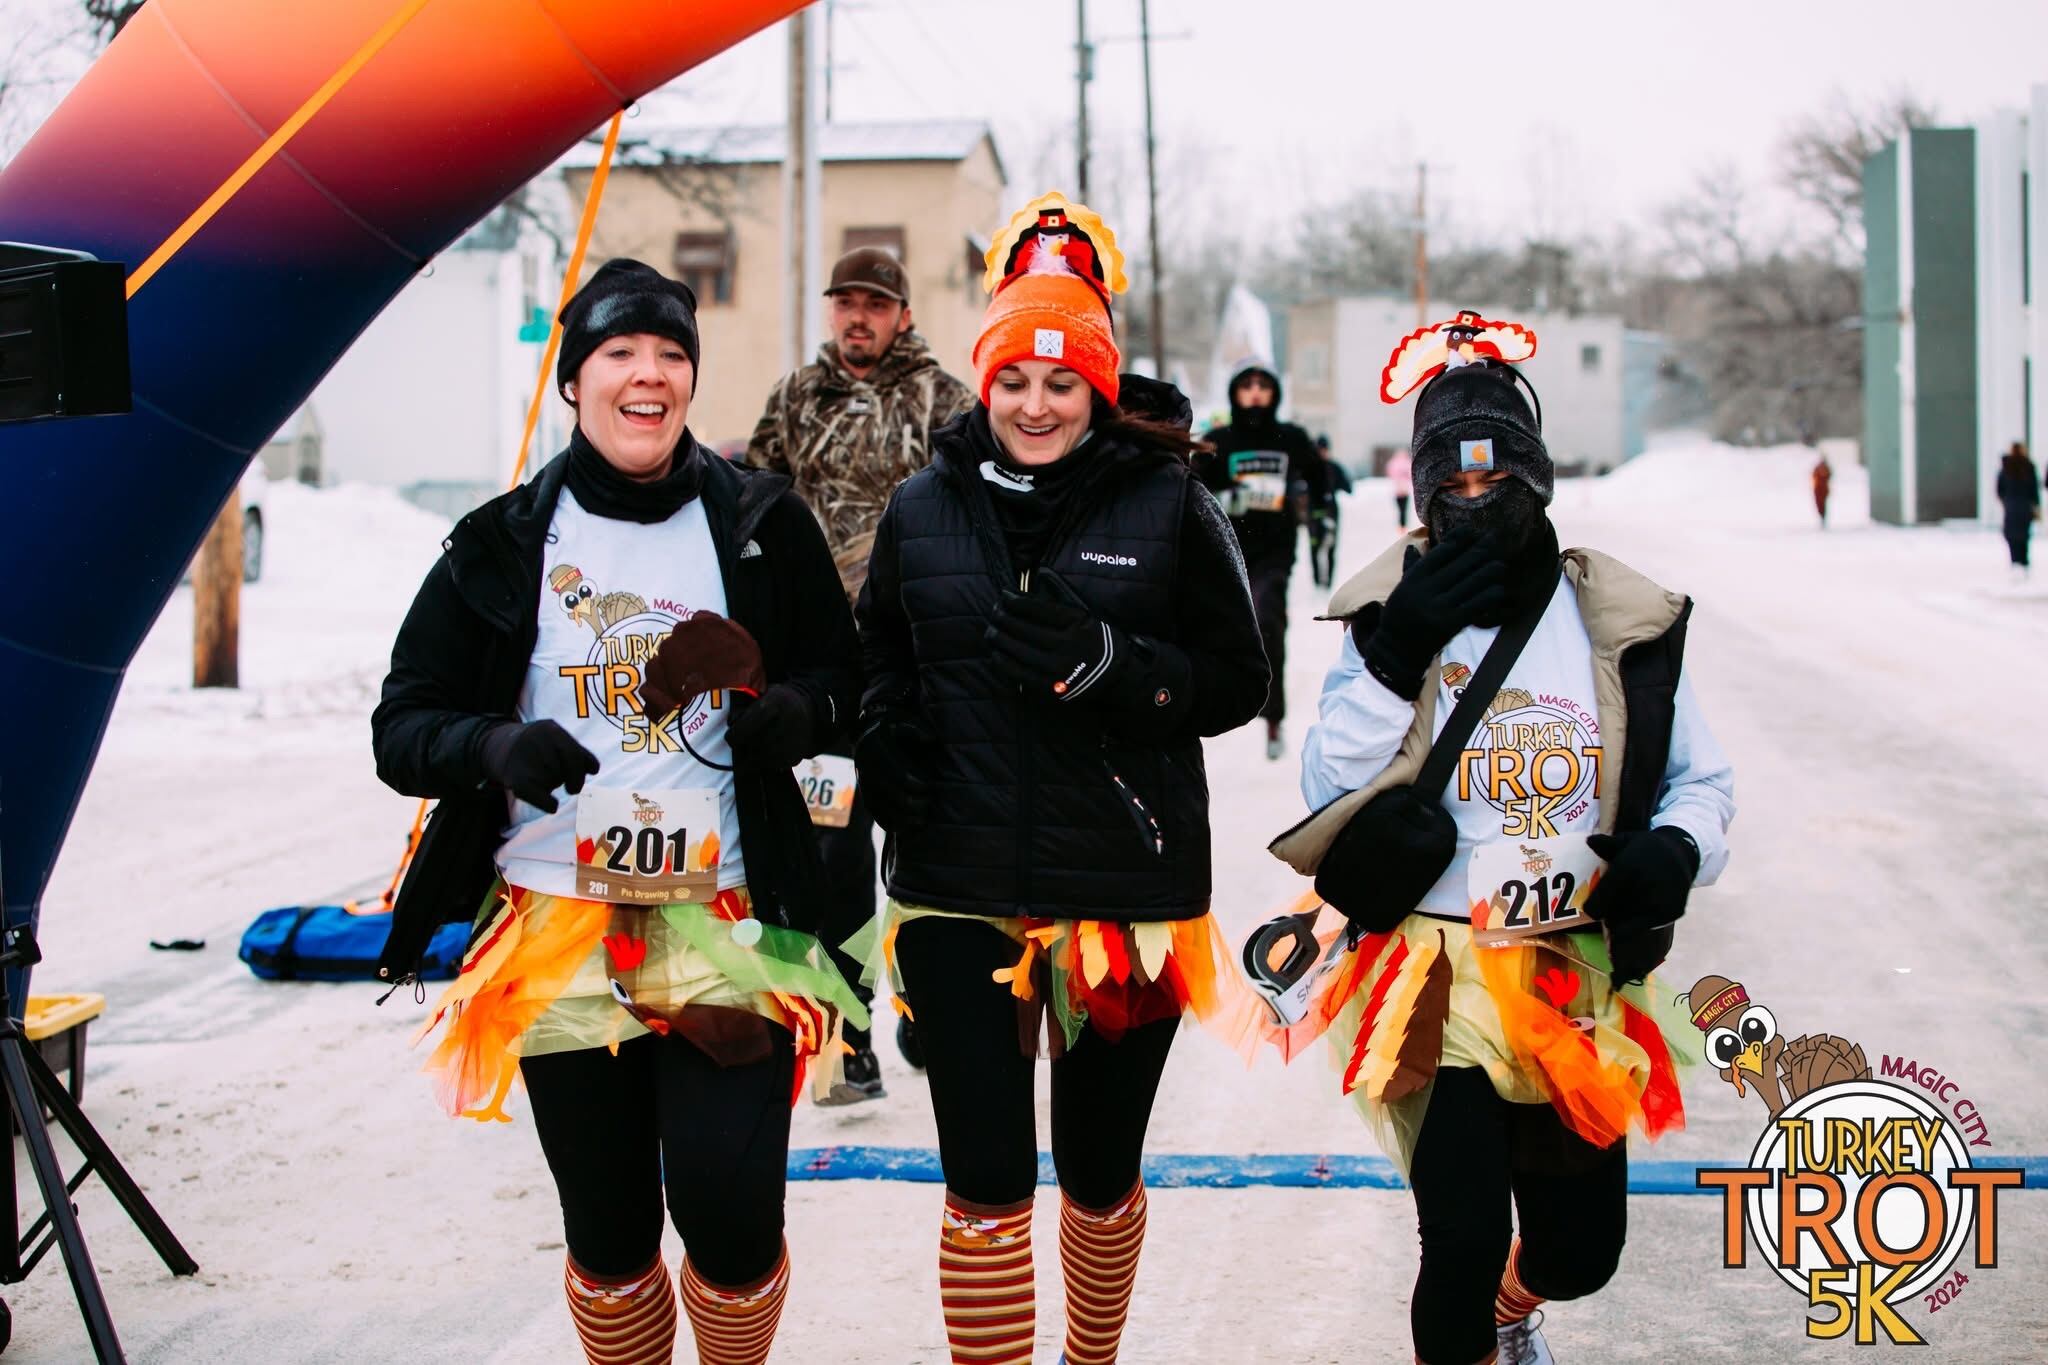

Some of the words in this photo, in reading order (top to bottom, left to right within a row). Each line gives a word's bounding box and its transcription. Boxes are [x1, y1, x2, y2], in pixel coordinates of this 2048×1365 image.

[1081, 551, 1137, 566] uupalee
[601, 632, 673, 668] TURK
[685, 711, 709, 735] 2024
[1538, 693, 1581, 714] MAGIC
[1579, 711, 1600, 735] CITY
[621, 707, 684, 754] 5K
[1487, 721, 1576, 752] TURKEY
[632, 810, 665, 822] TROT
[1502, 795, 1560, 839] 5K
[1564, 800, 1589, 822] 2024
[606, 825, 688, 876] 201
[1521, 858, 1553, 873] TROT
[588, 881, 609, 896] 201
[634, 889, 670, 901] Drawing
[1501, 871, 1580, 929] 212
